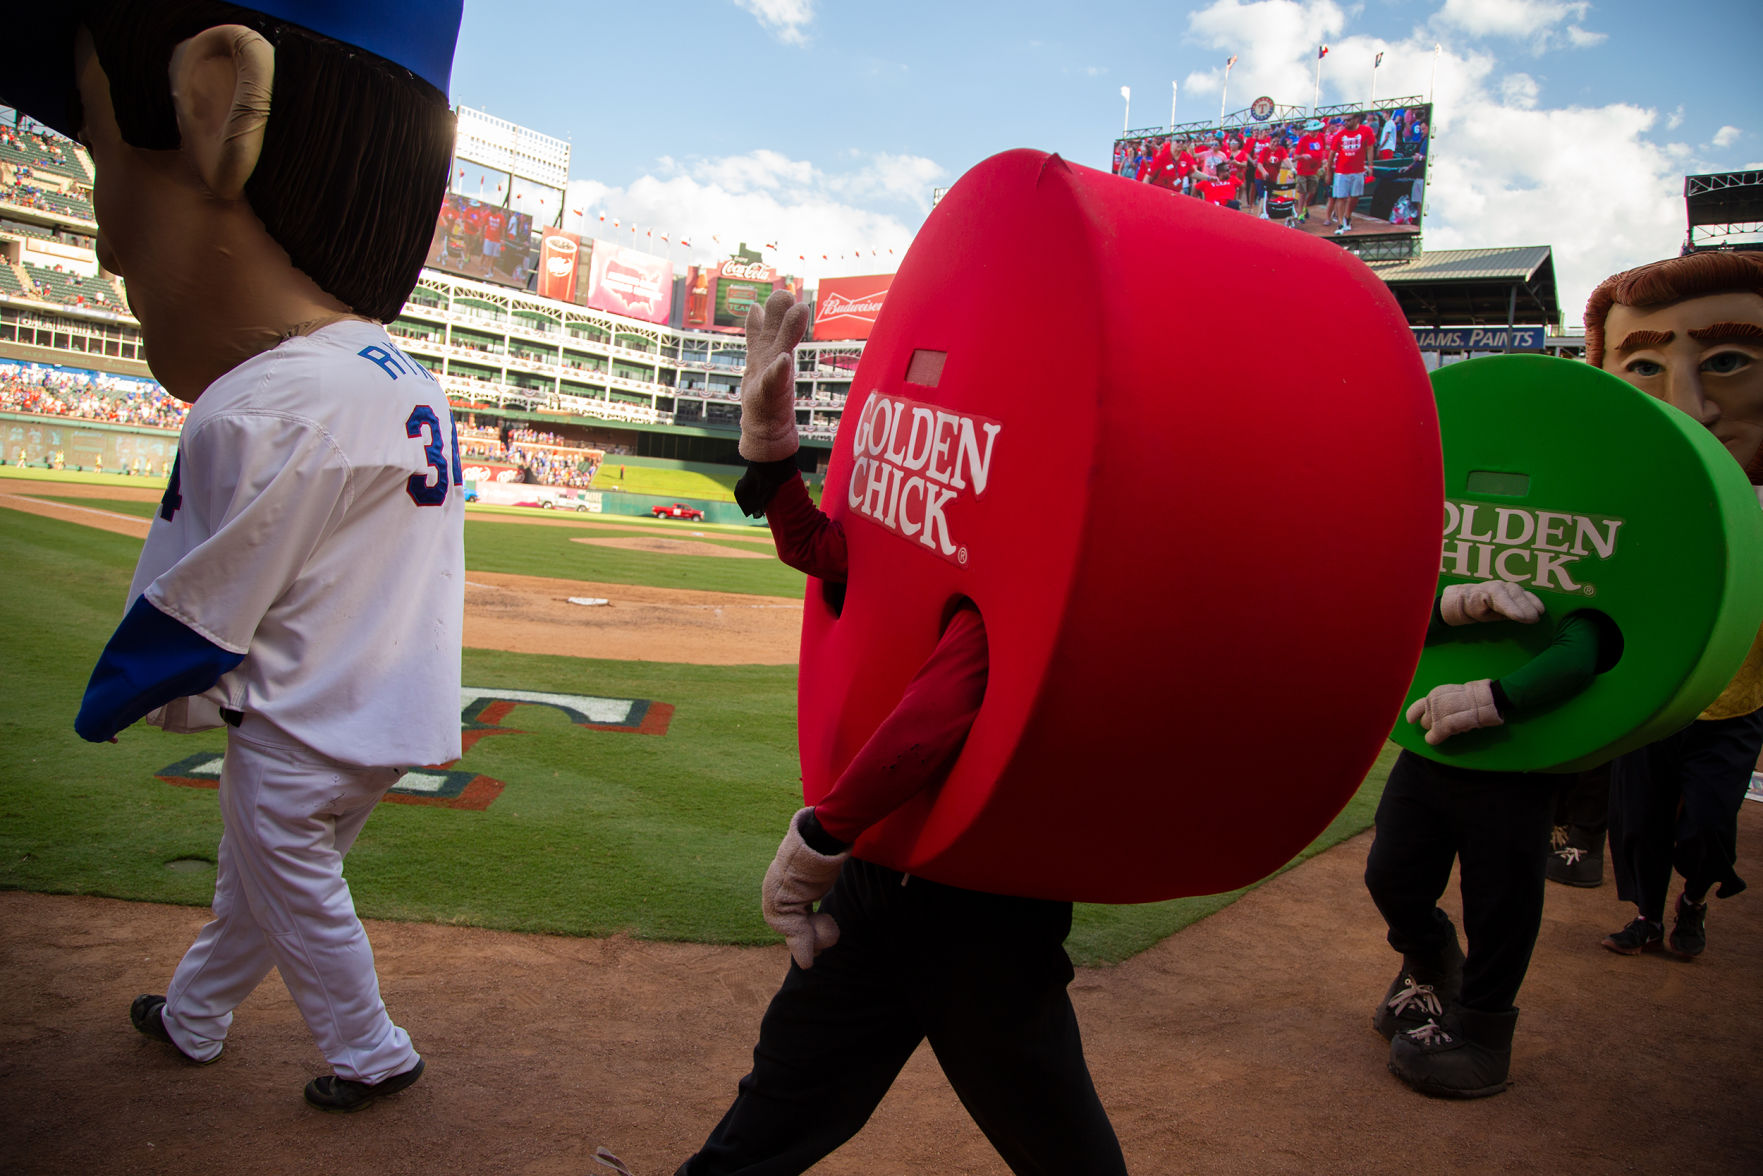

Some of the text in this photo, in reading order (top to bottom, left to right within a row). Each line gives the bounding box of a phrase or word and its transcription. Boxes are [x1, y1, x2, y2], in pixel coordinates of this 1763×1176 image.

[853, 392, 1002, 495] GOLDEN
[848, 457, 957, 555] CHICK
[1443, 501, 1622, 559] LDEN
[1440, 539, 1581, 591] HICK
